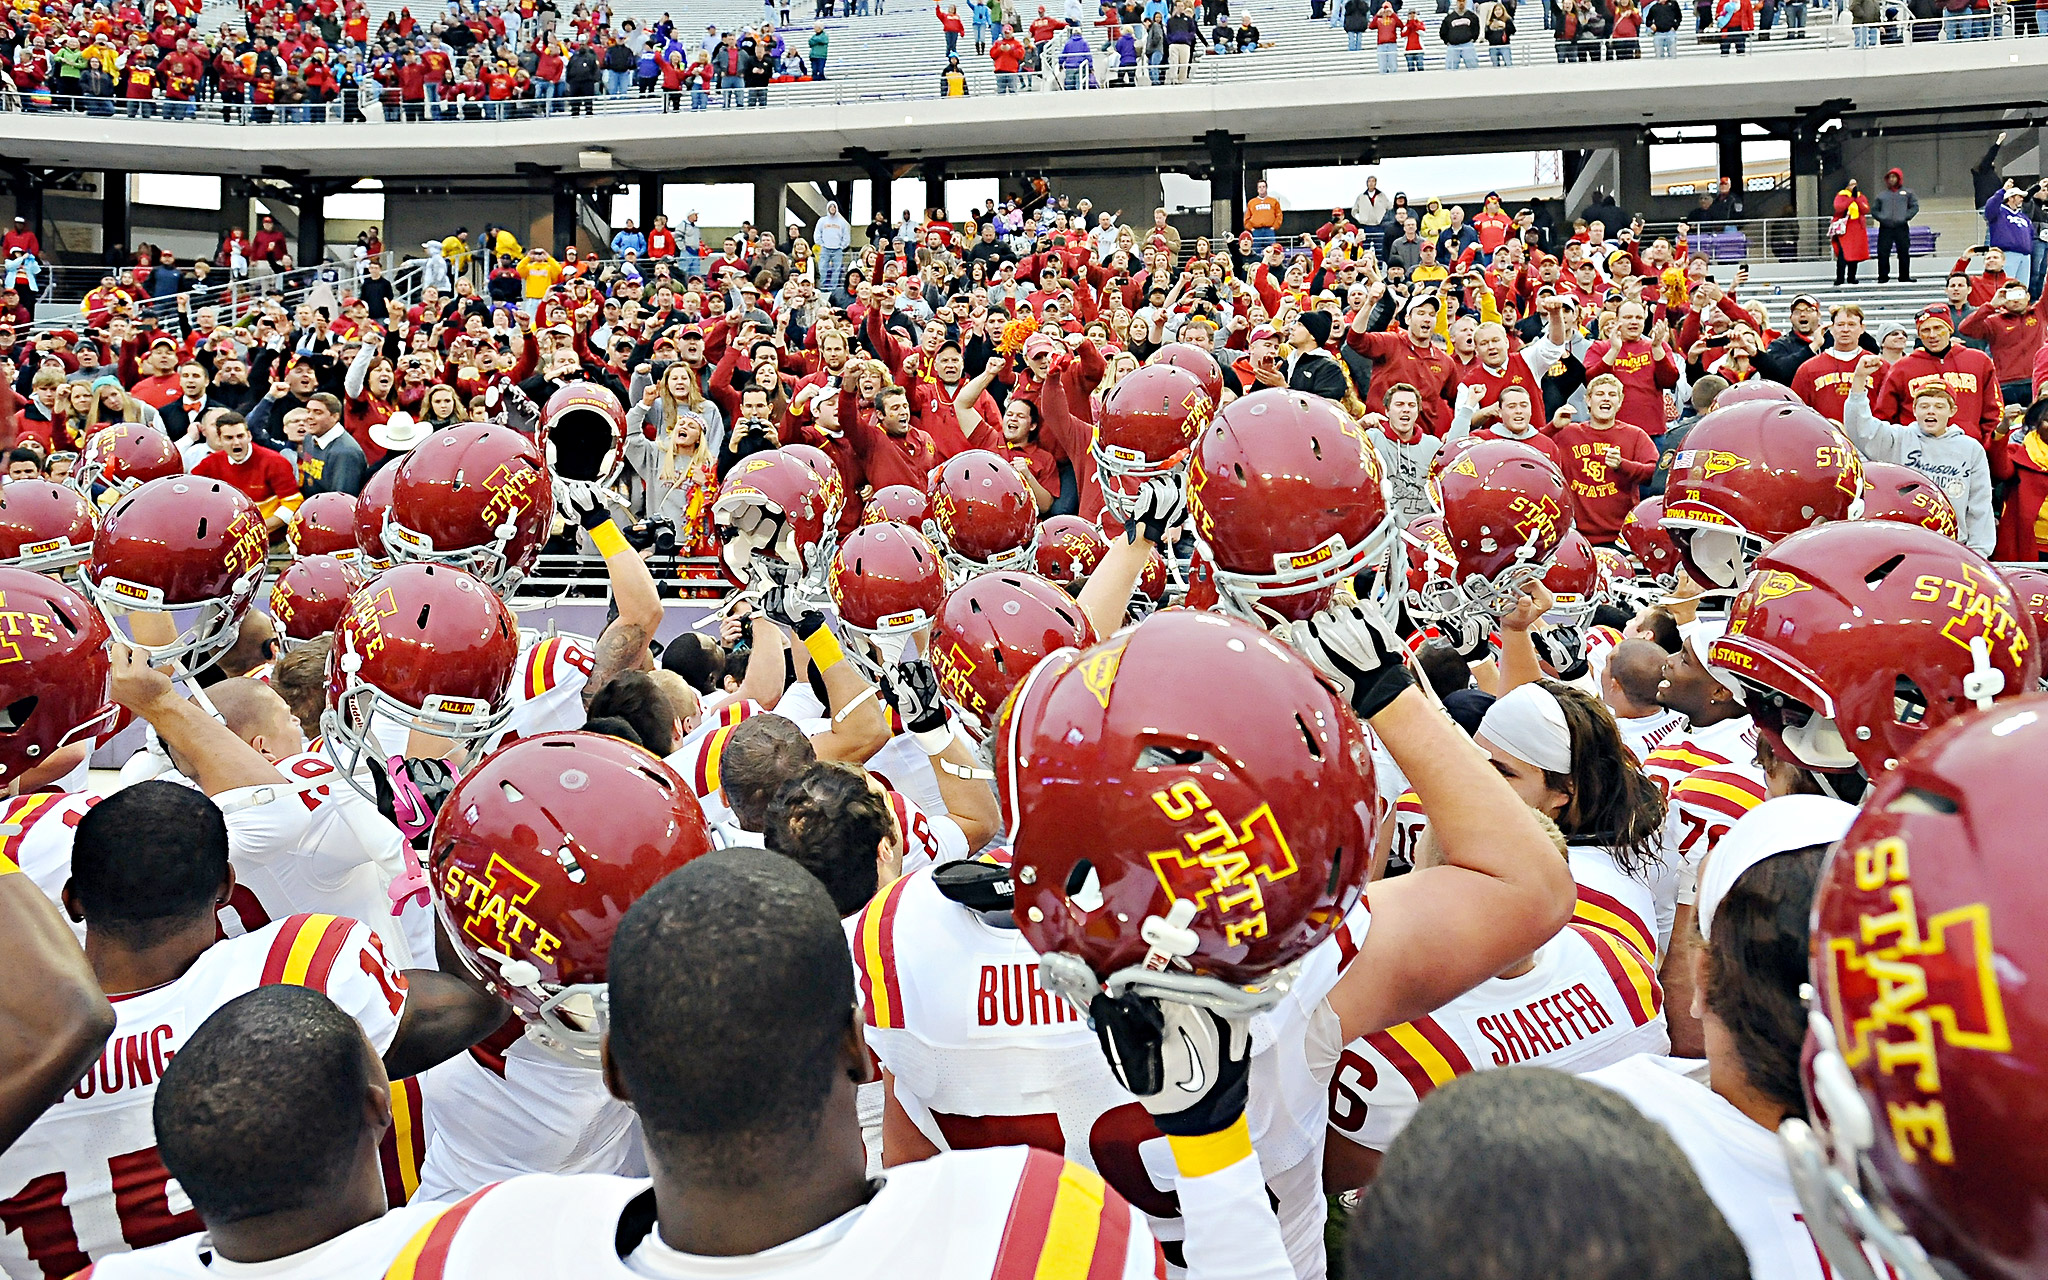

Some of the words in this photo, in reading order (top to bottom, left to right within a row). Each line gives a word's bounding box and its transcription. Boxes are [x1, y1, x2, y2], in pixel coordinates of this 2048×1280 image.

[1572, 443, 1620, 460] IOW
[1904, 450, 1972, 478] Swanson's
[481, 466, 539, 527] STATE
[1571, 480, 1618, 498] STATE
[1686, 490, 1700, 501] 78
[1509, 496, 1557, 548] STATE
[1688, 510, 1725, 525] STATE
[224, 523, 267, 573] STATE
[1061, 533, 1096, 566] STATE
[1292, 555, 1316, 567] ALL
[1317, 546, 1332, 560] IN
[116, 583, 133, 595] ALL
[134, 588, 147, 599] IN
[1732, 620, 1748, 634] 67
[1911, 574, 2030, 668] STATE
[1717, 648, 1753, 669] STATE
[931, 648, 987, 714] STATE
[440, 702, 460, 712] ALL
[1152, 780, 1268, 948] STATE
[443, 865, 561, 965] STATE
[1855, 836, 1956, 1166] STATE
[1476, 982, 1614, 1065] SHAEFFER
[54, 1024, 175, 1104] UNG
